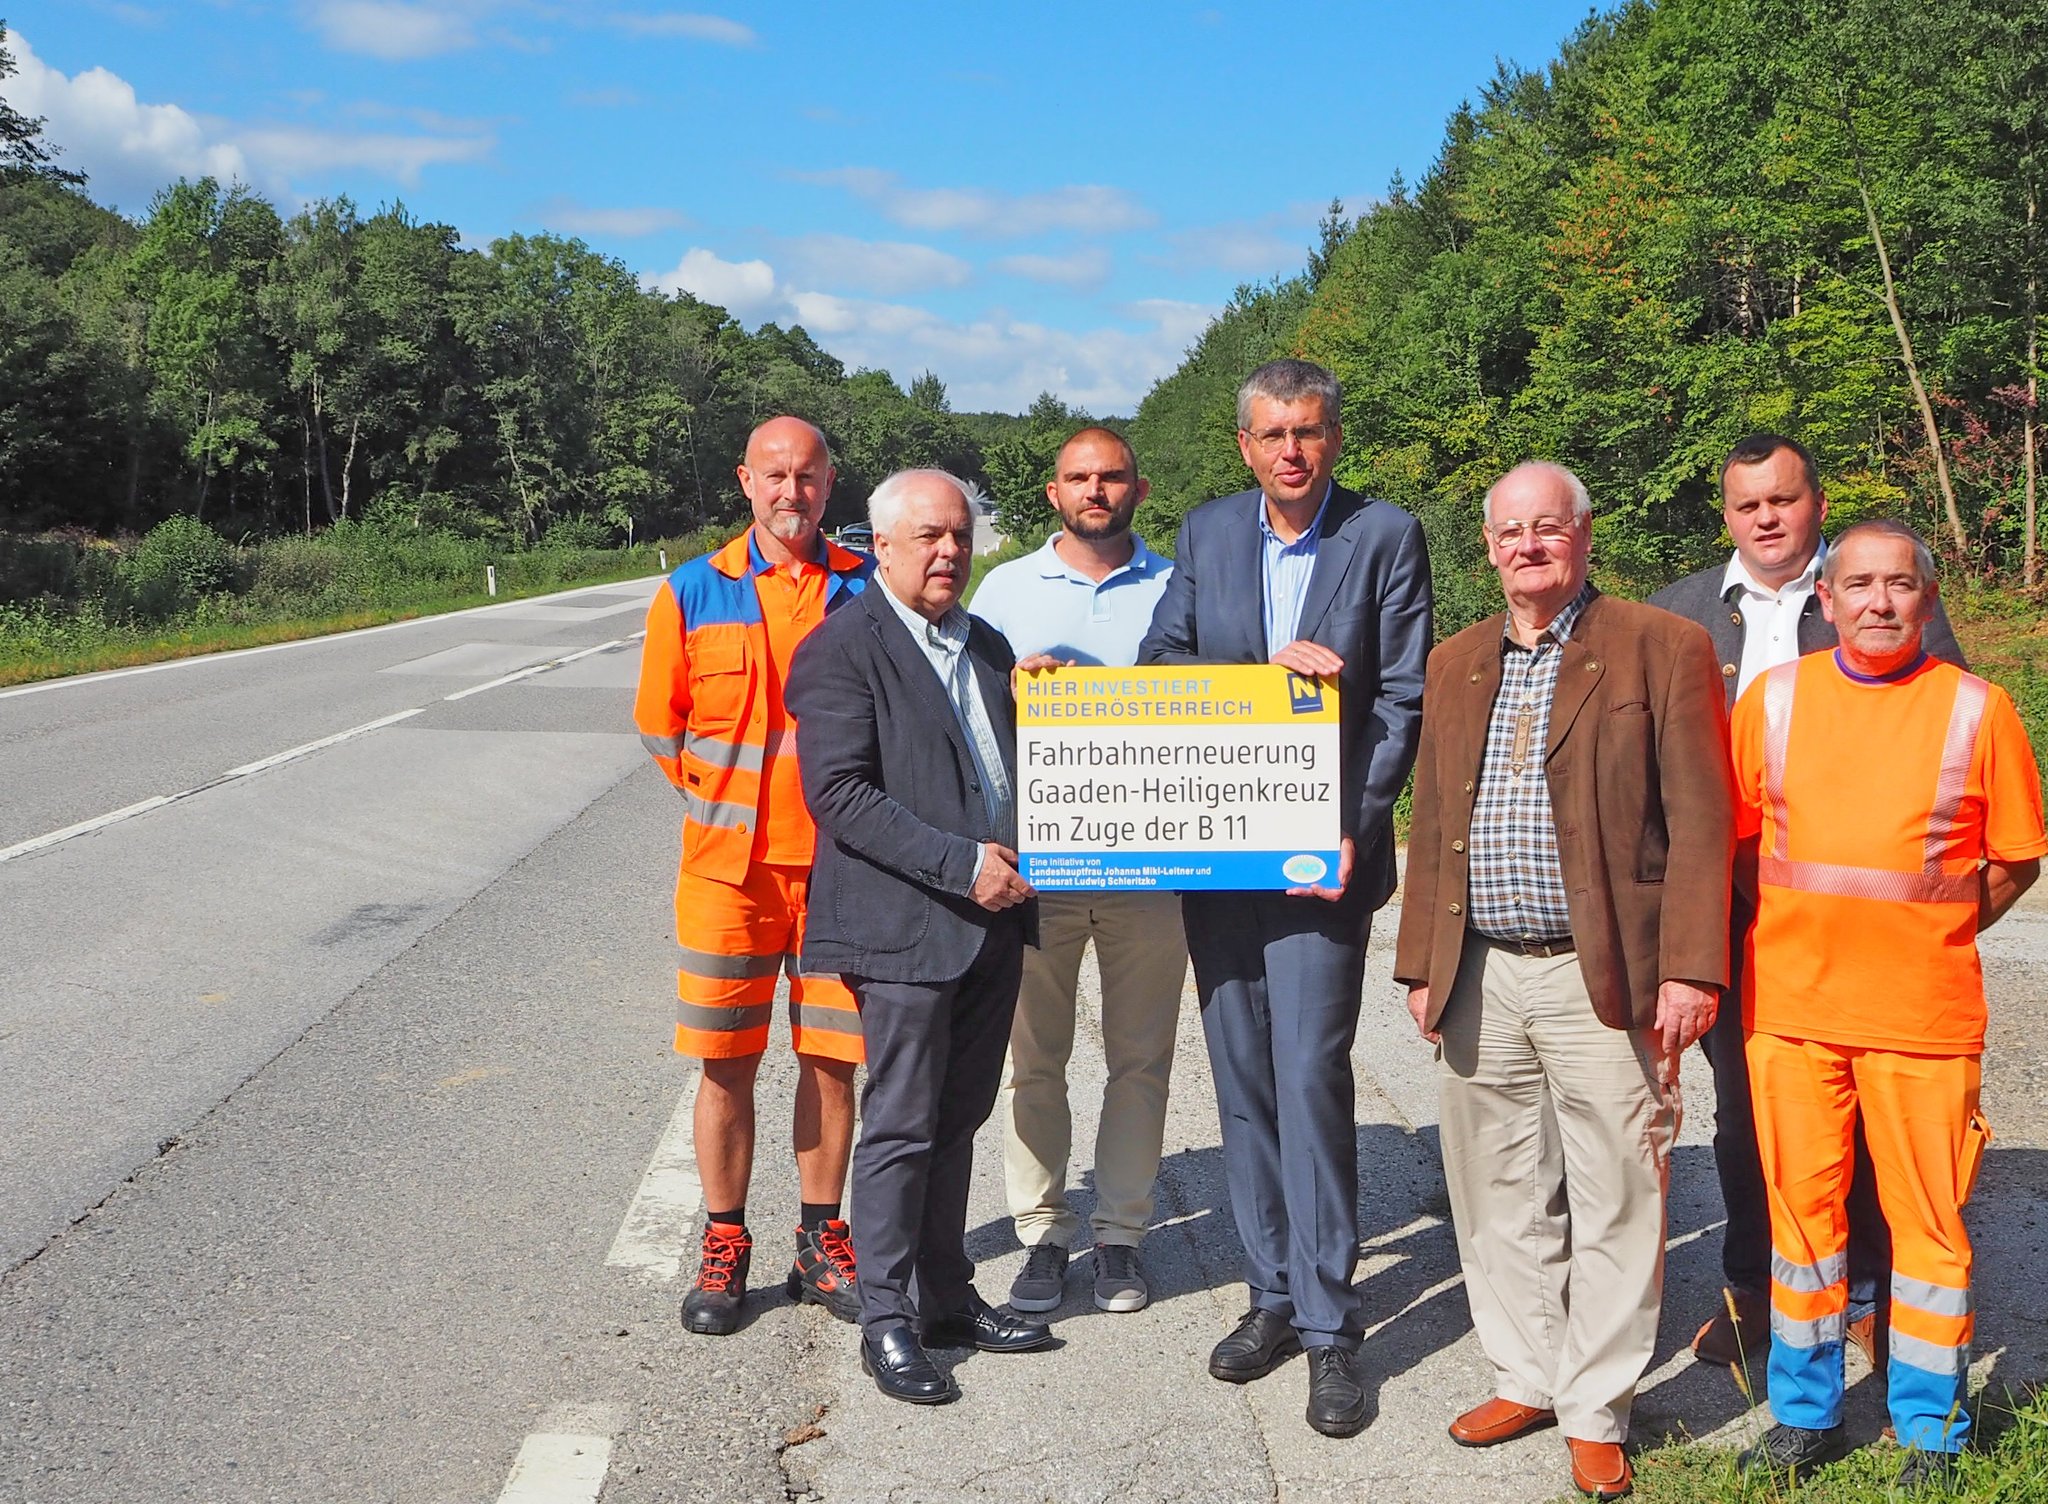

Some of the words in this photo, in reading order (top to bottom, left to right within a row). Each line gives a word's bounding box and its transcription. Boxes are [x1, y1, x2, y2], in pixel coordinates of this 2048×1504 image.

[1027, 681, 1077, 696] HIER
[1084, 680, 1212, 696] INVESTIERT
[1027, 699, 1252, 717] NIEDERÖSTERREICH
[1029, 740, 1316, 770] Fahrbahnerneuerung
[1029, 776, 1330, 808] Gaaden-Heiligenkreuz
[1028, 815, 1060, 842] im
[1070, 815, 1135, 847] Zuge
[1145, 815, 1188, 840] der
[1199, 815, 1213, 840] B
[1224, 815, 1247, 840] 11
[1030, 858, 1047, 866] Eine
[1049, 858, 1084, 866] Initiative
[1030, 867, 1102, 877] Landeshauptfrau
[1104, 867, 1141, 876] Johanna
[1143, 866, 1194, 876] Mikl-Leitner
[1196, 866, 1211, 875] und
[1030, 877, 1072, 886] Landesrat
[1075, 877, 1106, 887] Ludwig
